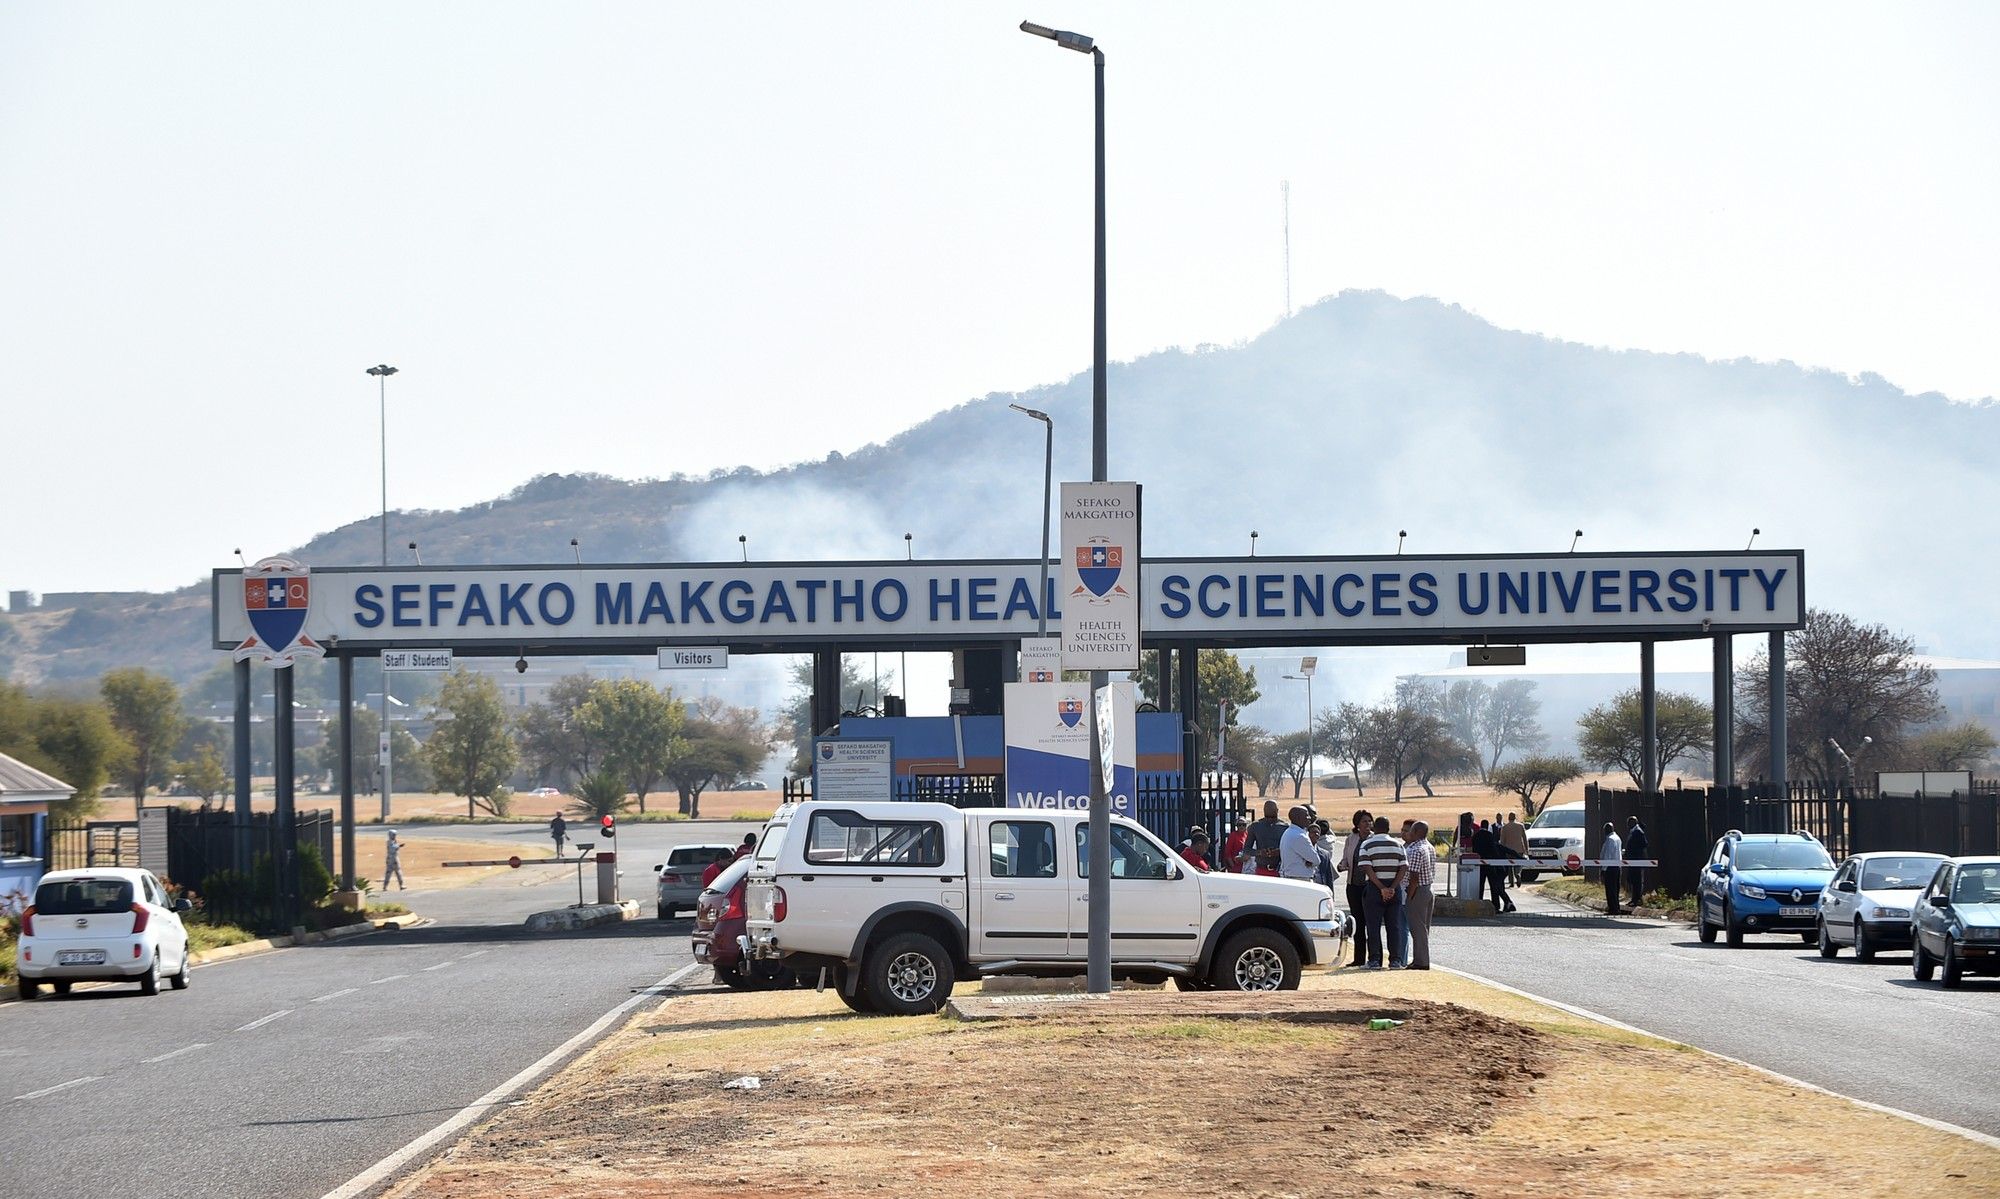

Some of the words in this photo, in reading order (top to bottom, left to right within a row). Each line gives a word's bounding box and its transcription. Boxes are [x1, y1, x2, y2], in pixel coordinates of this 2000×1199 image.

[1076, 498, 1121, 507] SEFAKO
[1064, 510, 1134, 519] MAKGATHO
[354, 582, 575, 628] SEFAKO
[595, 578, 908, 625] MAKGATHO
[929, 577, 1062, 622] HEAL
[1160, 572, 1439, 619] SCIENCES
[1458, 568, 1787, 615] UNIVERSITY
[1079, 621, 1121, 630] HEALTH
[1075, 632, 1126, 641] SCIENCES
[1068, 643, 1133, 653] UNIVERSITY
[385, 654, 406, 667] Staff
[412, 654, 449, 666] Students
[674, 652, 713, 664] Visitors
[1016, 790, 1128, 810] Welcoe
